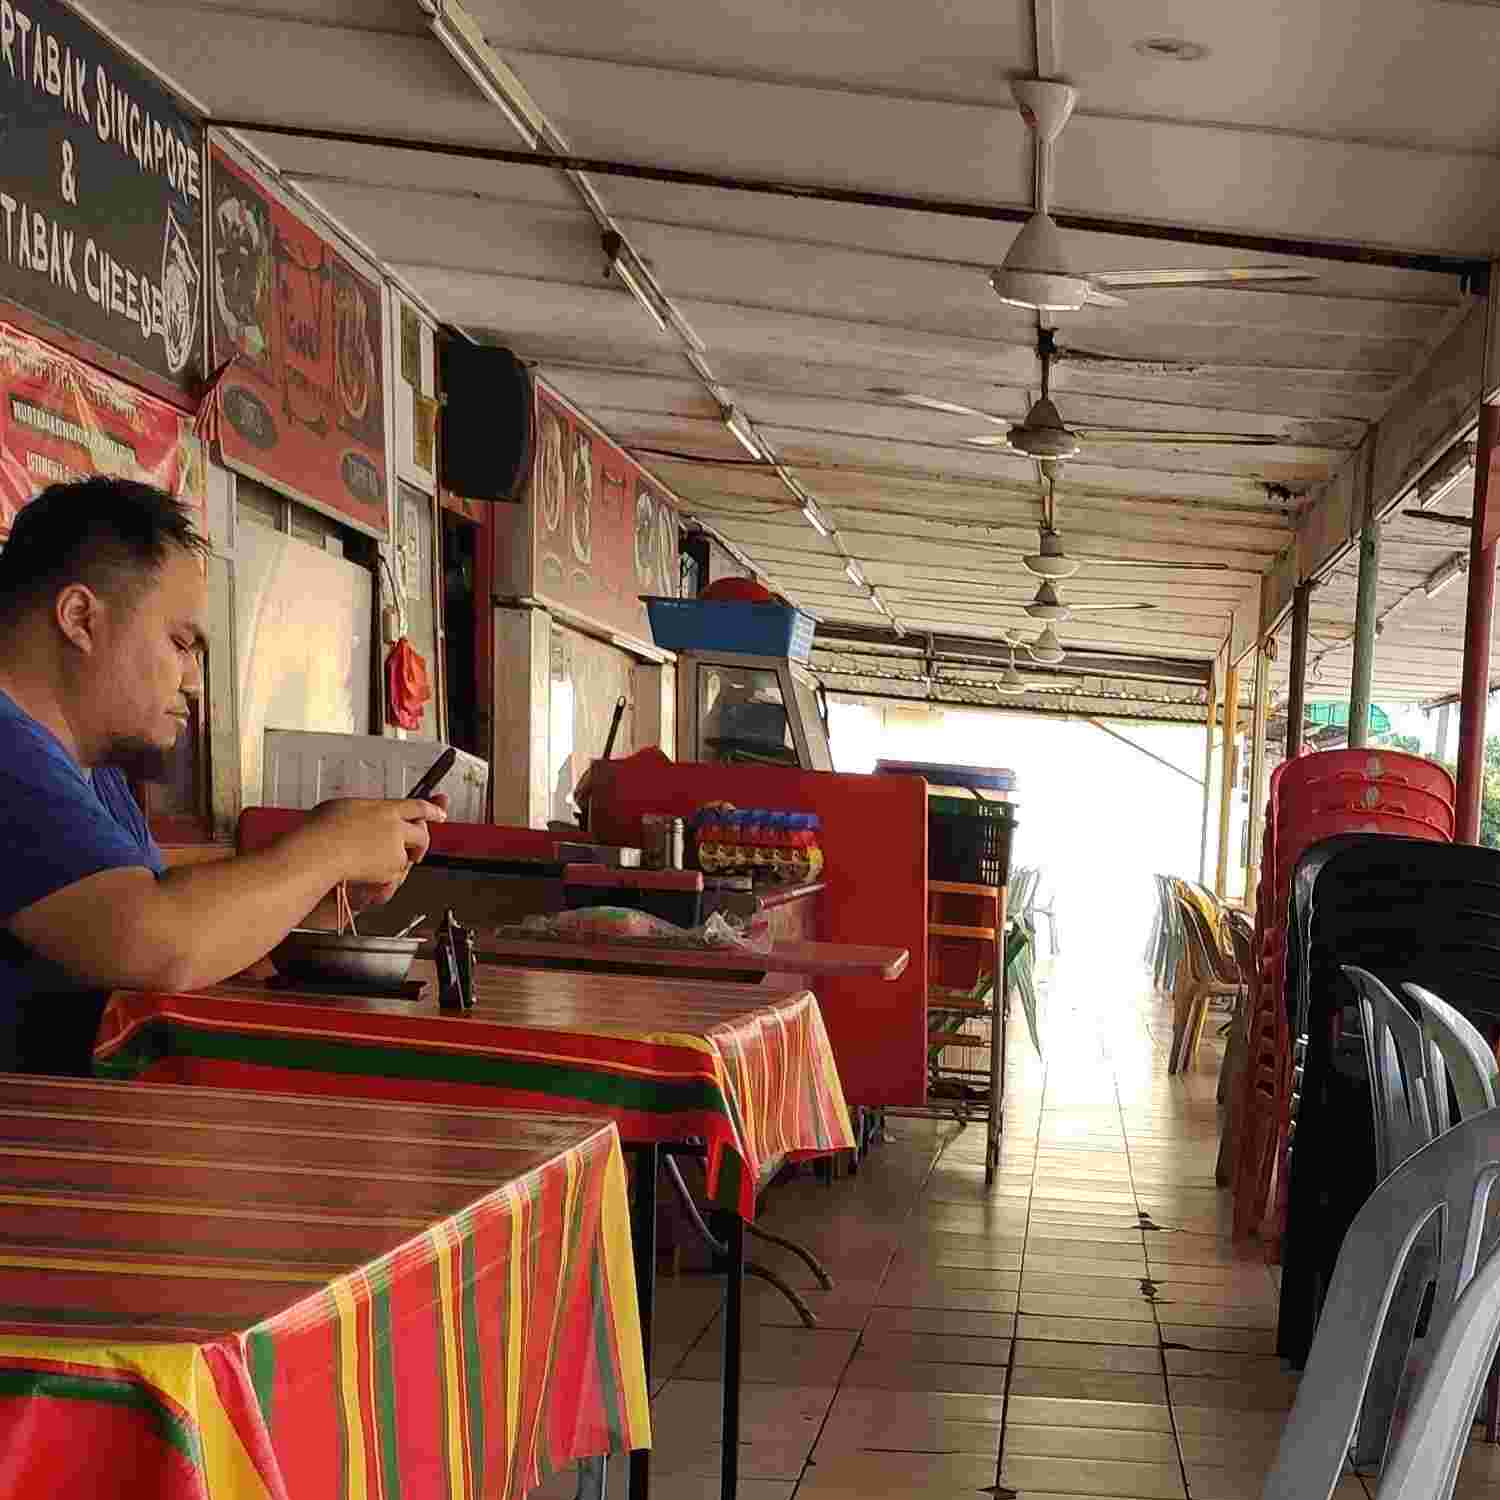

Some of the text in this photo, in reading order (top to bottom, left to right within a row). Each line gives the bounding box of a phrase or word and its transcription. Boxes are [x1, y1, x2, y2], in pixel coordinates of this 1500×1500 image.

[0, 0, 201, 205] RTABAK SINGAPORE
[61, 138, 78, 207] &
[0, 191, 167, 340] TABAK CHEESE
